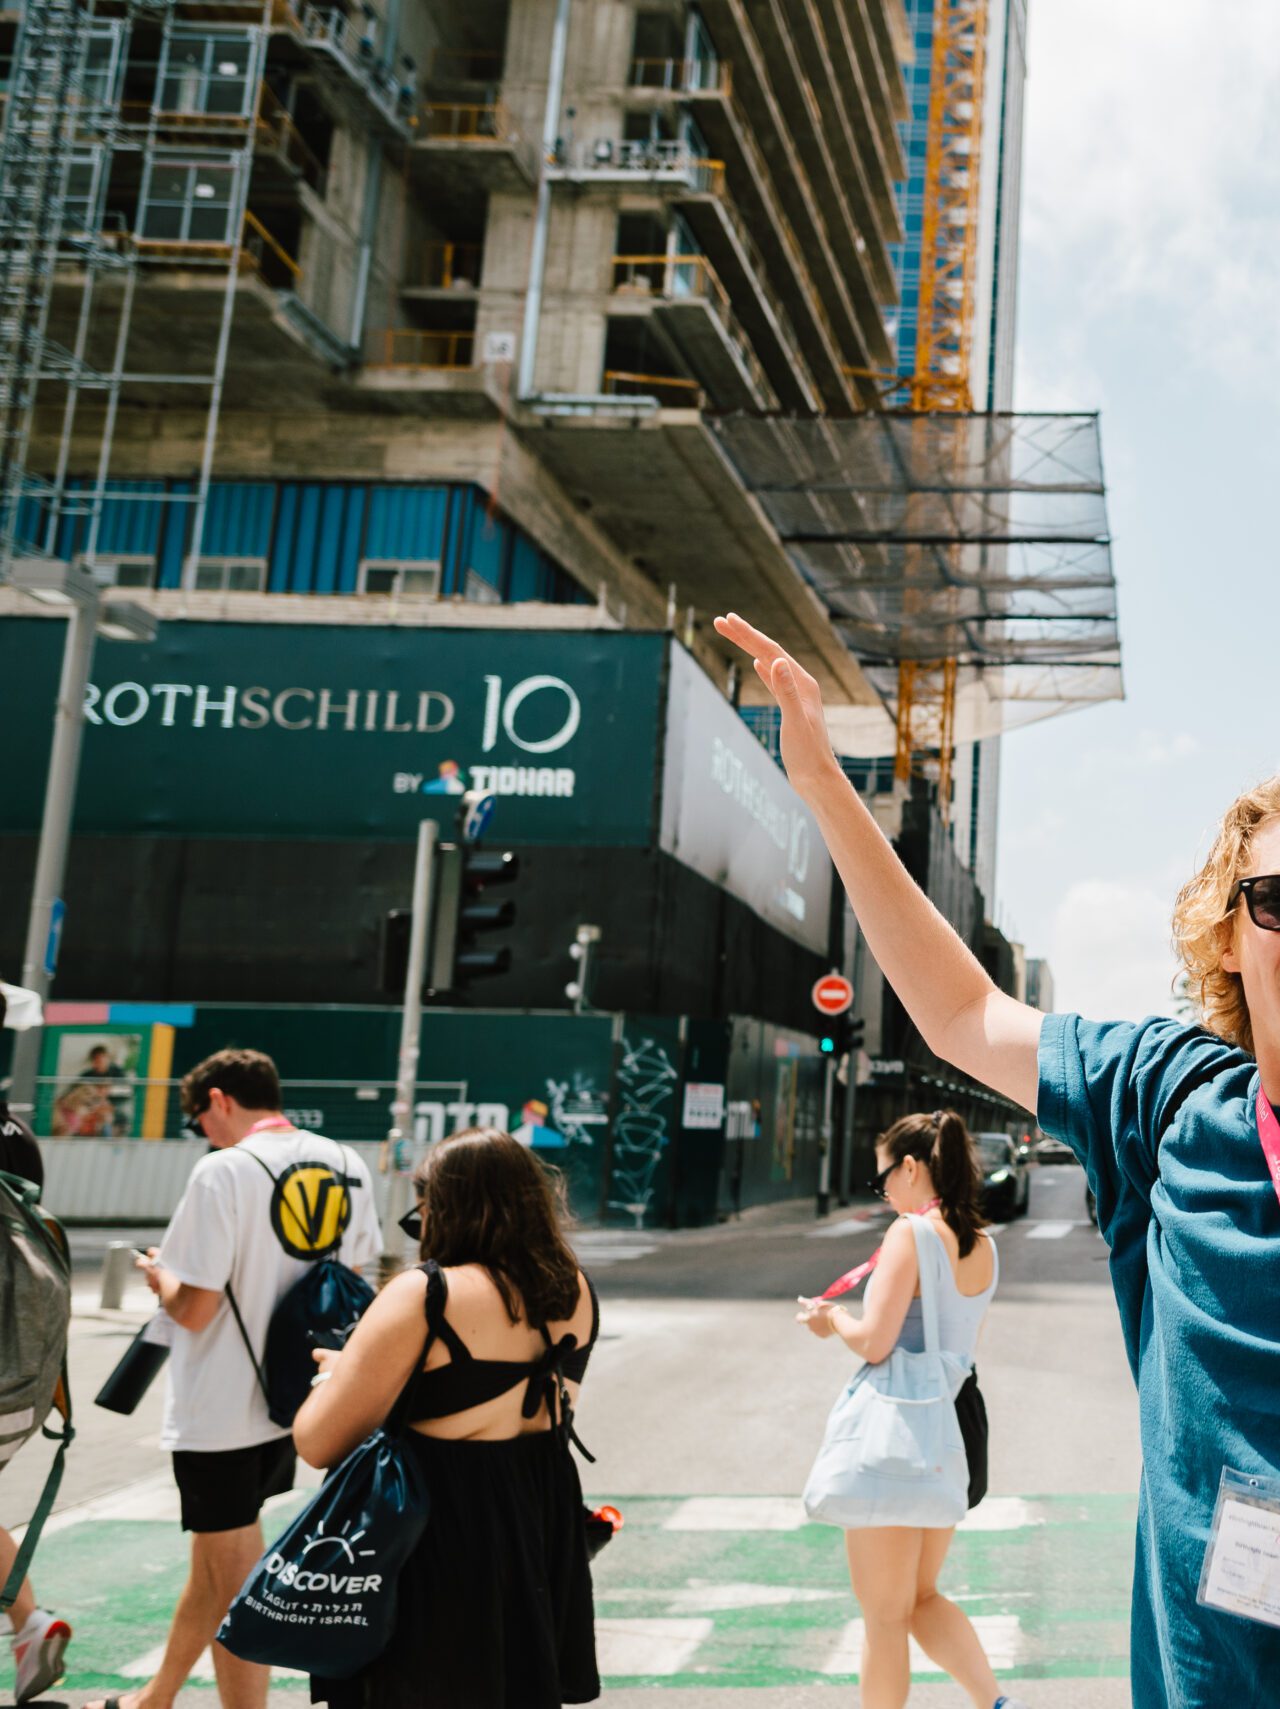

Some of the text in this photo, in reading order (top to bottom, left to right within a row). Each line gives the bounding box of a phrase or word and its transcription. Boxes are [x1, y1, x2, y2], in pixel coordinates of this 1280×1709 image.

[482, 674, 581, 754] 10
[393, 765, 576, 798] BY TIDHAR
[264, 1551, 382, 1595] DISCOVER
[244, 1595, 369, 1627] BIRTHRIGHT ISRAEL
[261, 1588, 300, 1611] TAGLIT
